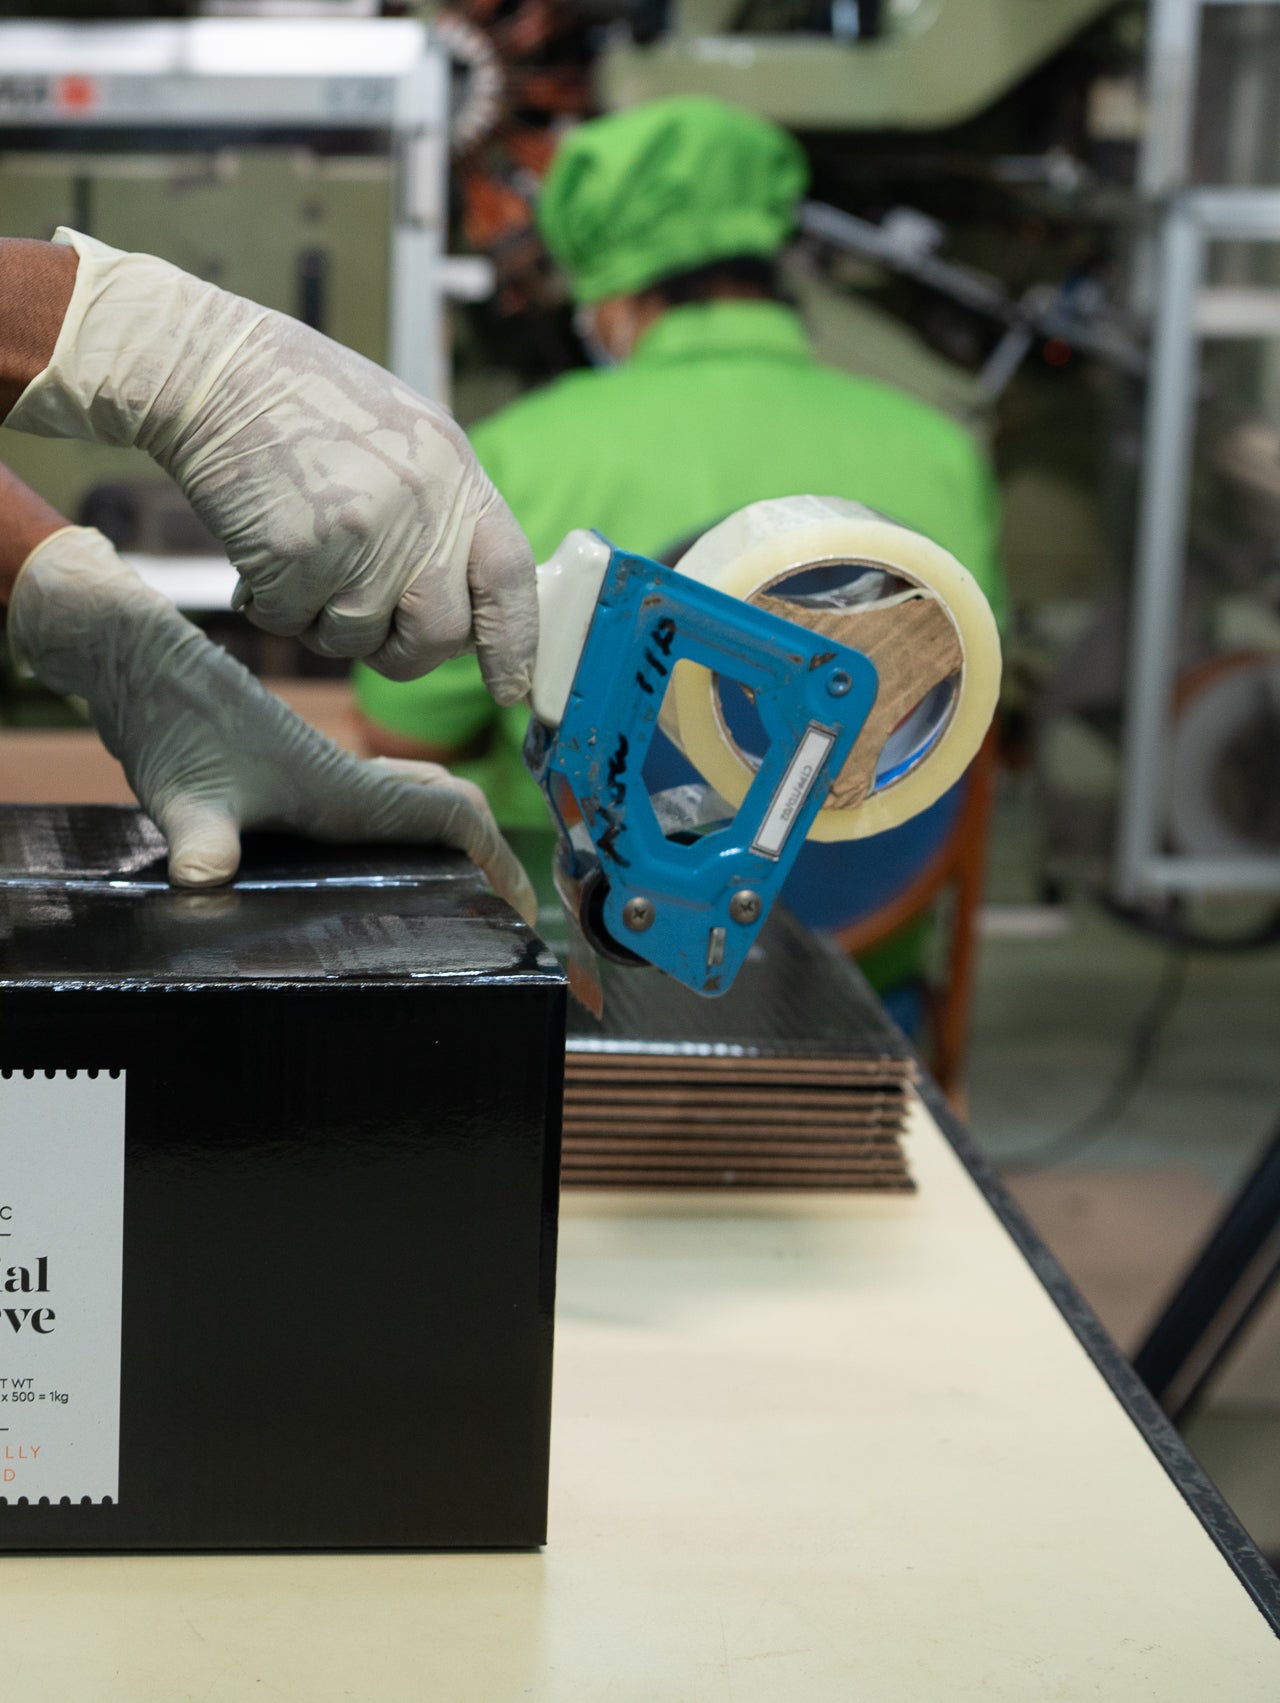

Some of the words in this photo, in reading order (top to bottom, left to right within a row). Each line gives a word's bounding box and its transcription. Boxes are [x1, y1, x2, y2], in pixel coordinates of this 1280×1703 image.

[11, 1378, 35, 1389] WT
[0, 1393, 9, 1403] x
[11, 1391, 35, 1403] 500
[49, 1390, 69, 1405] 1kg
